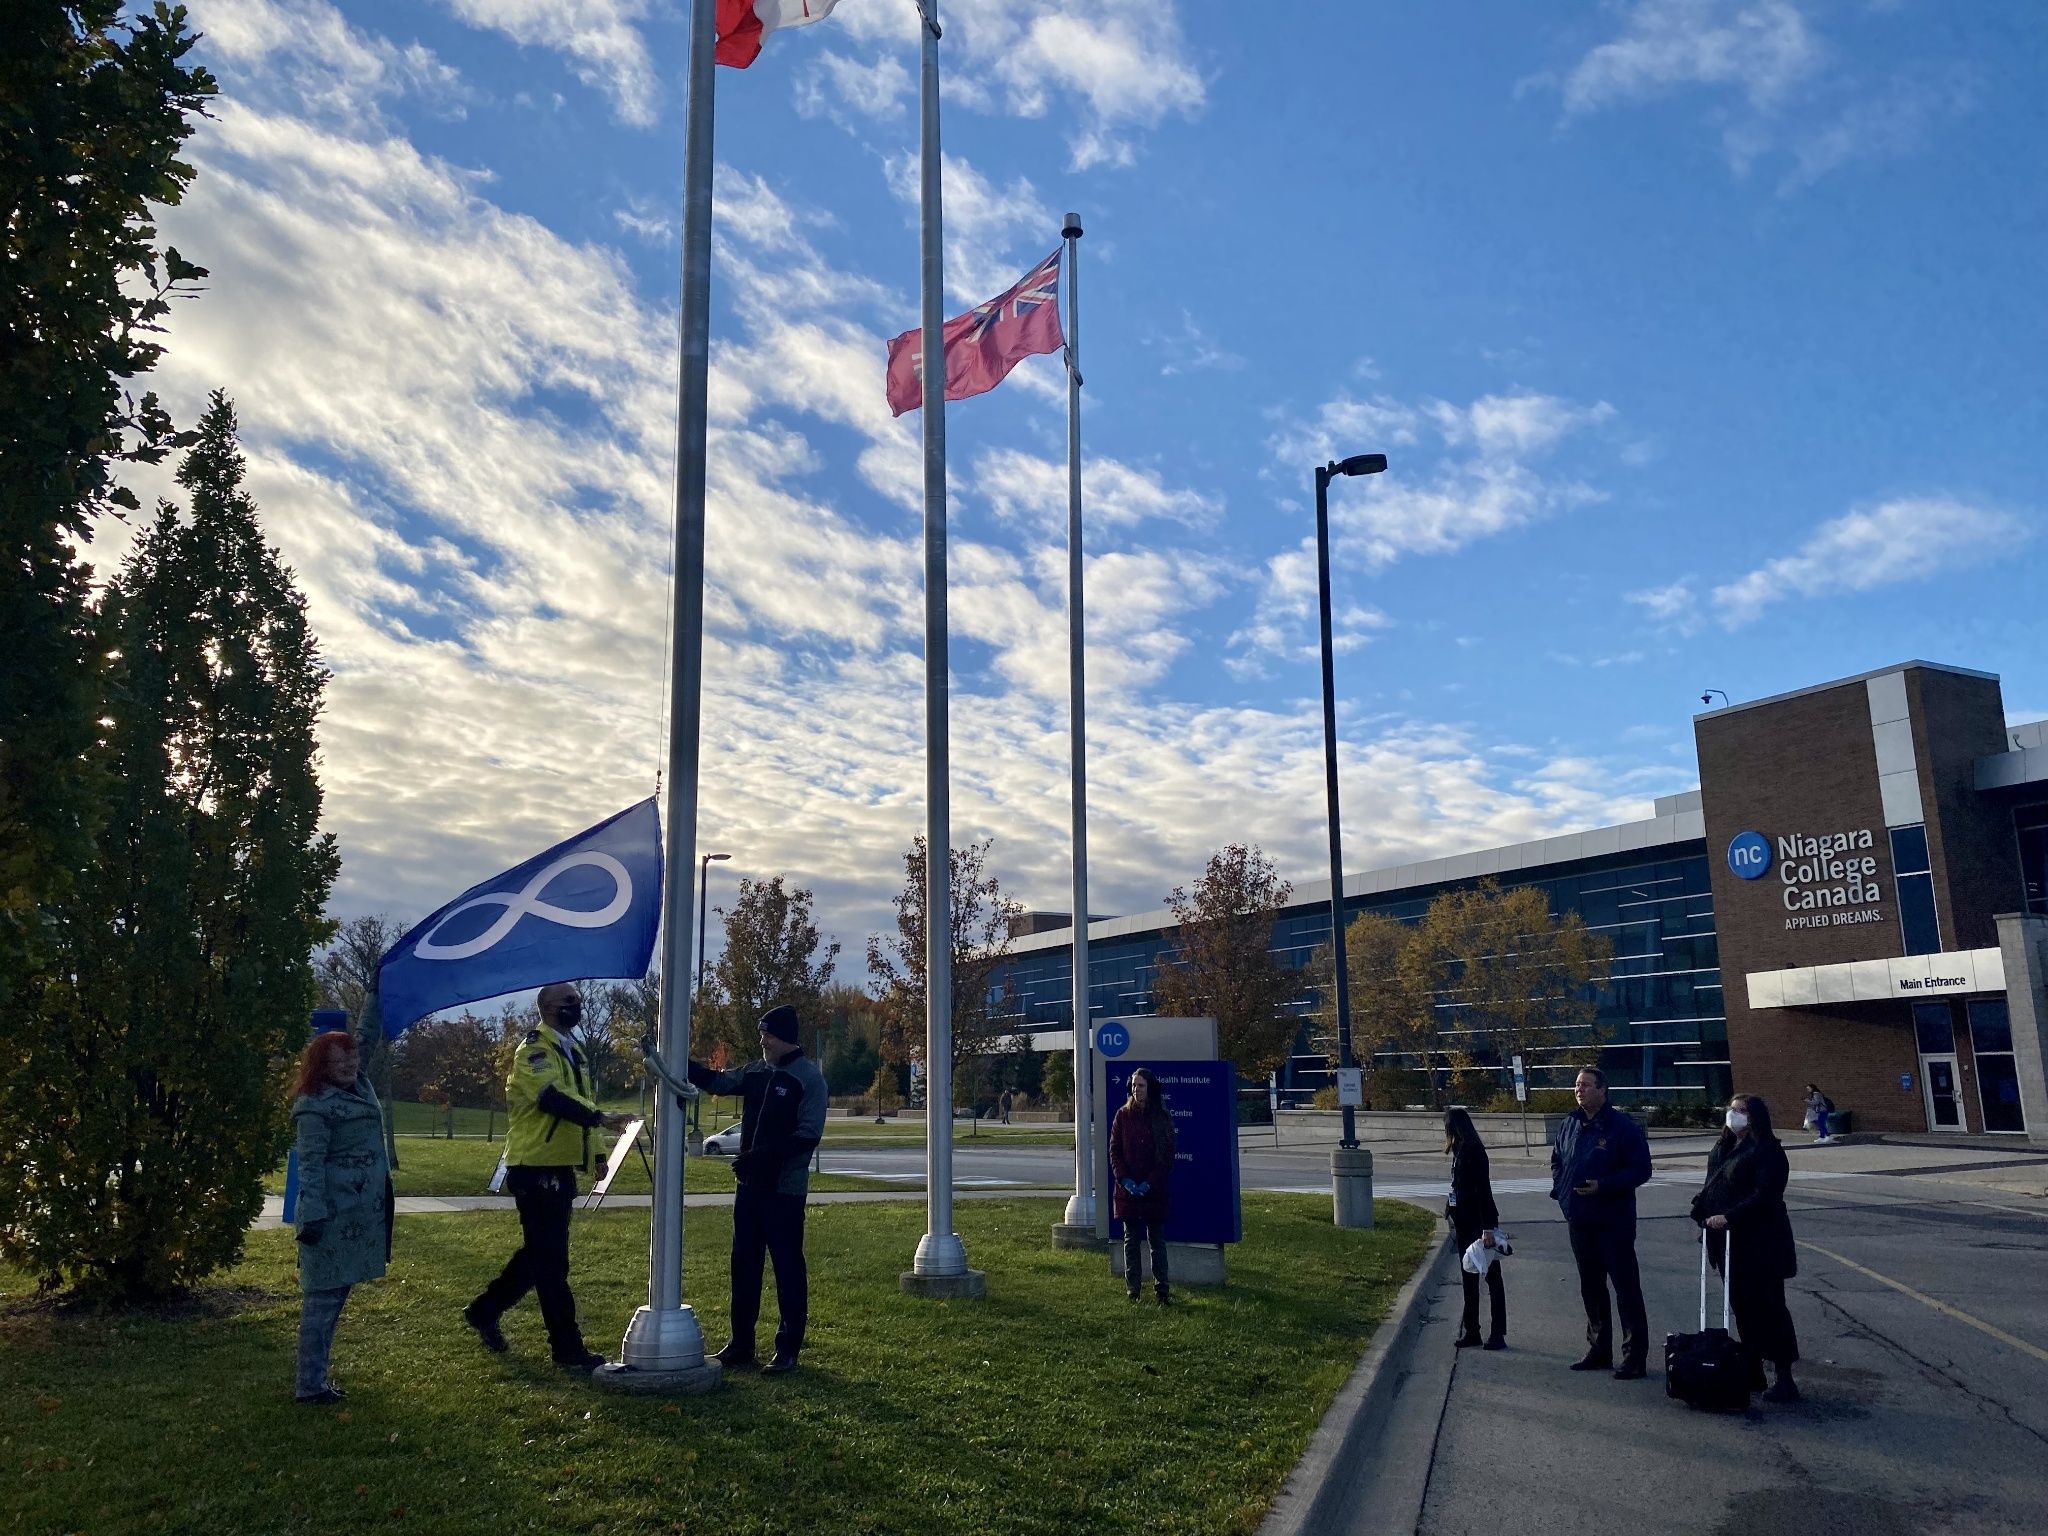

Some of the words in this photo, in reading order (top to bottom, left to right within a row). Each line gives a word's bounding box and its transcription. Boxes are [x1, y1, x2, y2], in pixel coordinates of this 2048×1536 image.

[1777, 829, 1873, 860] Niagara
[1734, 845, 1762, 866] nc
[1780, 856, 1877, 885] College
[1783, 878, 1881, 911] Canada
[1785, 914, 1830, 930] APPLIED
[1832, 909, 1884, 926] DREAMS.
[1900, 979, 1923, 990] Main
[1924, 976, 1966, 988] Entrance
[1102, 1033, 1123, 1046] nc
[1180, 1076, 1211, 1084] Institute
[1169, 1109, 1193, 1117] Centre
